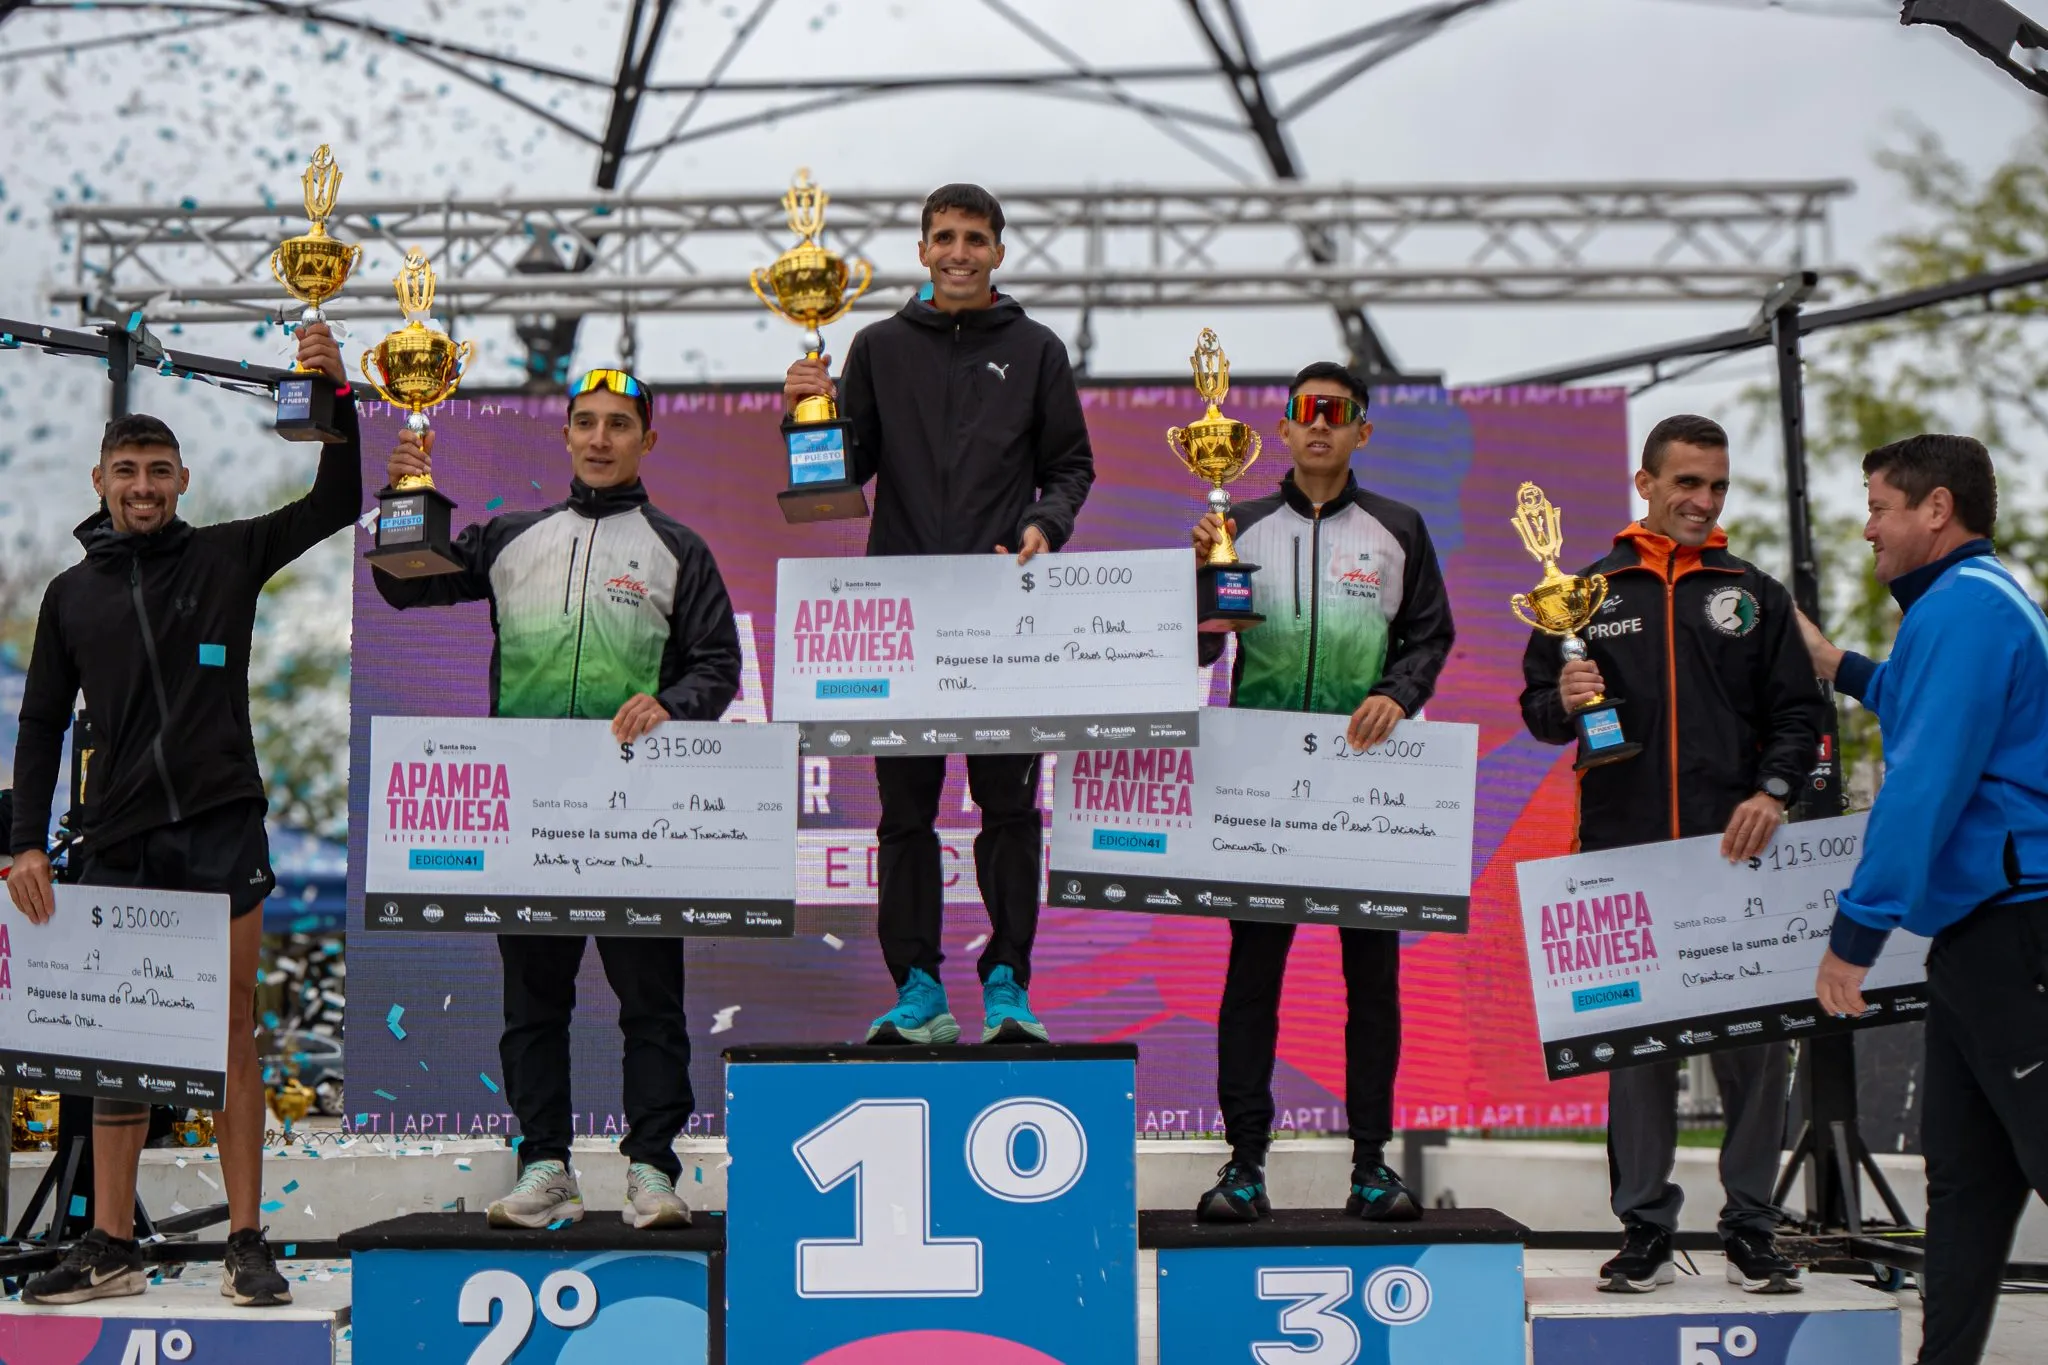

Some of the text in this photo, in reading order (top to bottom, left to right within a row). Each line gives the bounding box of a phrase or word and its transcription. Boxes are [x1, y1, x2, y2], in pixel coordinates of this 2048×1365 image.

[1021, 566, 1133, 592] $ 500.000
[611, 595, 640, 608] TEAM
[1346, 589, 1376, 599] TEAM
[794, 598, 915, 633] APAMPA
[936, 629, 964, 638] Santa
[967, 627, 991, 636] Rosa
[1015, 615, 1034, 634] 19
[1073, 625, 1086, 634] de
[1157, 622, 1182, 632] 2026
[1588, 617, 1643, 641] PROFE
[794, 632, 915, 663] TRAVIESA
[936, 653, 989, 667] Páguese
[992, 654, 1004, 664] la
[1007, 655, 1040, 664] suma
[1045, 653, 1060, 663] de
[1111, 726, 1136, 734] PAMPA
[1161, 729, 1186, 737] Pampa
[621, 737, 722, 763] $ 375.000
[1303, 732, 1318, 755] $
[1072, 749, 1195, 784] APAMPA
[386, 761, 511, 799] APAMPA
[532, 799, 561, 808] Santa
[563, 799, 588, 808] Rosa
[609, 791, 627, 809] 19
[672, 800, 685, 810] de
[757, 802, 783, 812] 2026
[1072, 777, 1193, 816] TRAVIESA
[1215, 785, 1243, 796] Santa
[1246, 788, 1270, 798] Rosa
[1291, 779, 1311, 799] 19
[1352, 794, 1365, 804] de
[1435, 800, 1460, 810] 2026
[386, 799, 510, 831] TRAVIESA
[1214, 814, 1266, 828] Páguese
[1271, 817, 1282, 828] la
[1285, 820, 1318, 830] suma
[1322, 820, 1338, 831] de
[532, 828, 585, 840] Páguese
[589, 829, 600, 839] la
[604, 831, 638, 840] suma
[642, 829, 658, 840] de
[92, 905, 103, 928] $
[707, 912, 732, 920] PAMPA
[1372, 904, 1408, 914] LA PAMPA
[1432, 912, 1457, 921] Pampa
[1540, 891, 1653, 942] APAMPA
[1674, 897, 1818, 930] Santa Rosa 19 de
[756, 918, 782, 926] Pampa
[1542, 928, 1658, 975] TRAVIESA
[1678, 943, 1729, 961] Páguese
[1732, 941, 1743, 951] la
[1747, 938, 1779, 950] suma
[1782, 933, 1798, 945] de
[27, 959, 48, 970] Santa
[50, 961, 69, 971] Rosa
[132, 967, 141, 977] de
[197, 973, 217, 983] 2026
[27, 987, 67, 1001] Páguese
[69, 989, 78, 1000] la
[81, 993, 106, 1003] suma
[109, 993, 121, 1004] de
[1906, 1001, 1928, 1010] Pamp
[157, 1079, 176, 1088] PAMPA
[186, 1086, 215, 1097] La Pampa
[404, 1113, 447, 1133] APT
[471, 1113, 513, 1133] APT
[683, 1114, 715, 1132] PT
[1144, 1110, 1190, 1131] APT
[1281, 1108, 1325, 1130] APT
